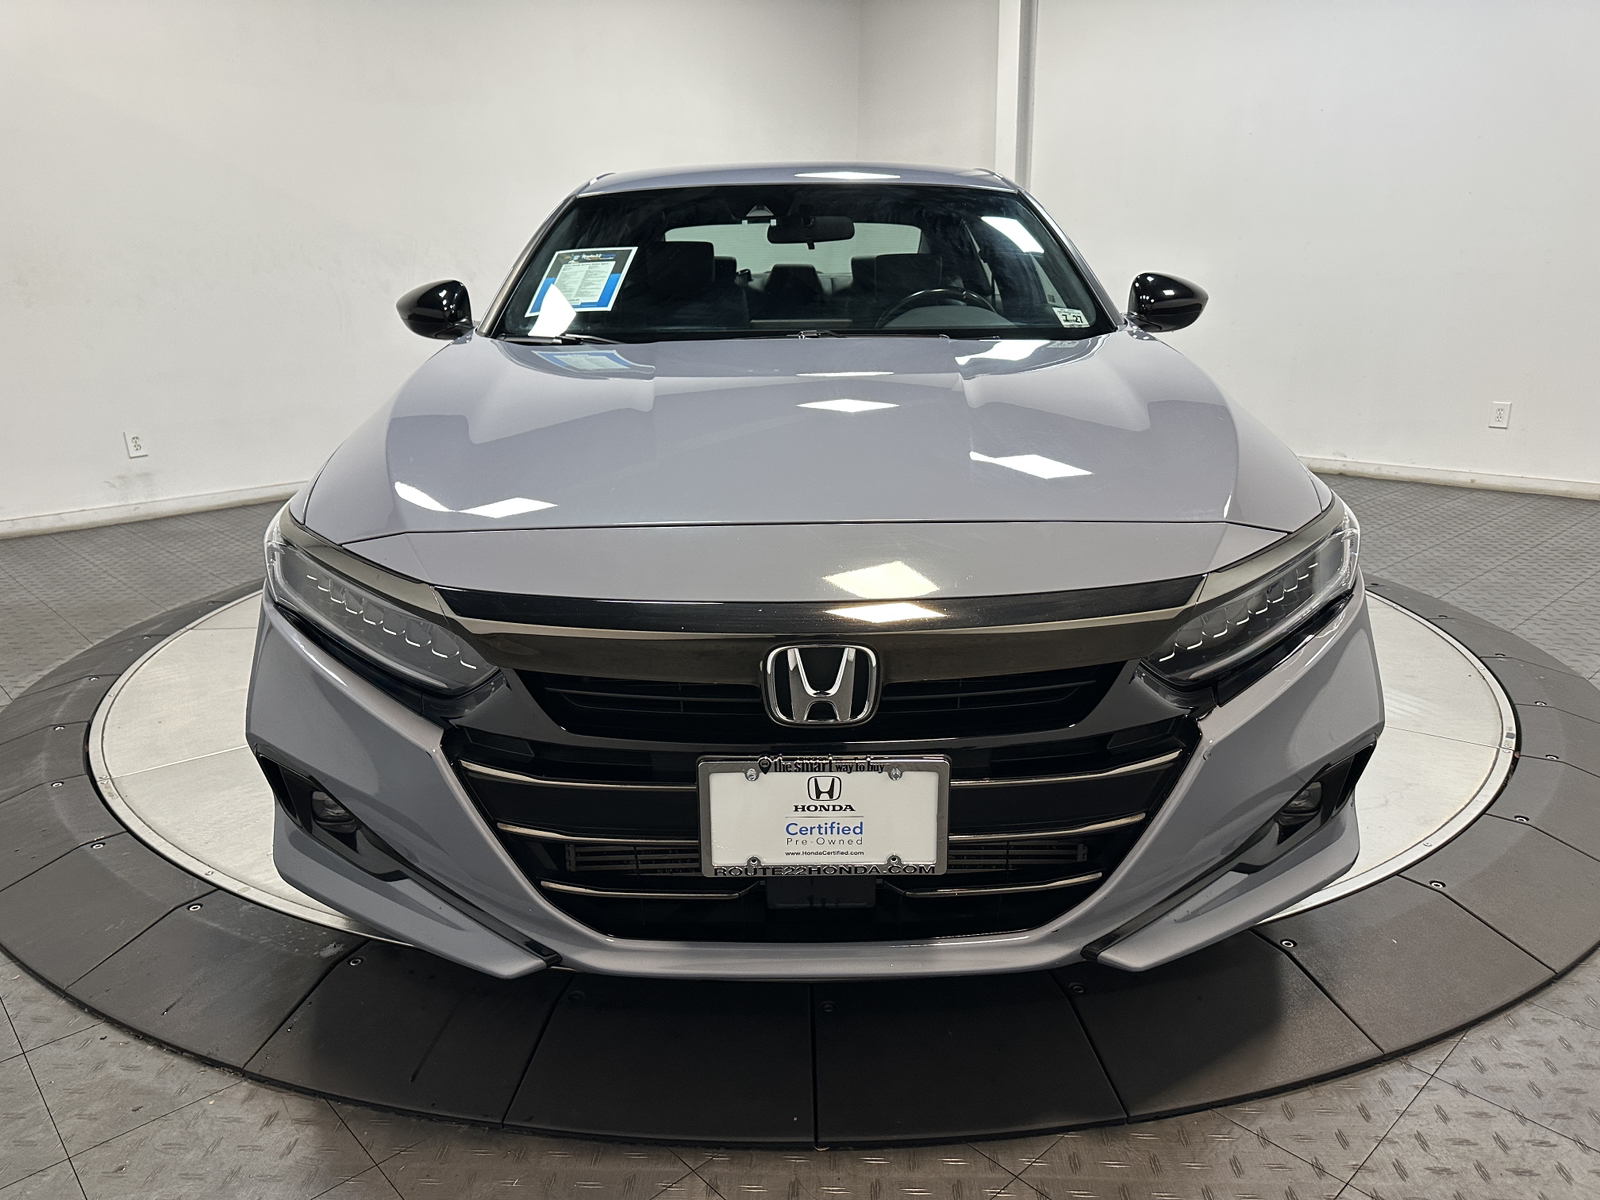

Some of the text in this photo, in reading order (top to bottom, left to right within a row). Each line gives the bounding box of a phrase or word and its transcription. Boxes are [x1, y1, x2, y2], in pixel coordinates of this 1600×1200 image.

[774, 757, 885, 774] the smart way to buy
[793, 804, 856, 812] HONDA
[785, 821, 864, 836] Certified
[786, 836, 863, 846] Pre-Owned
[713, 865, 936, 877] ROUTE22HONDA.COM
